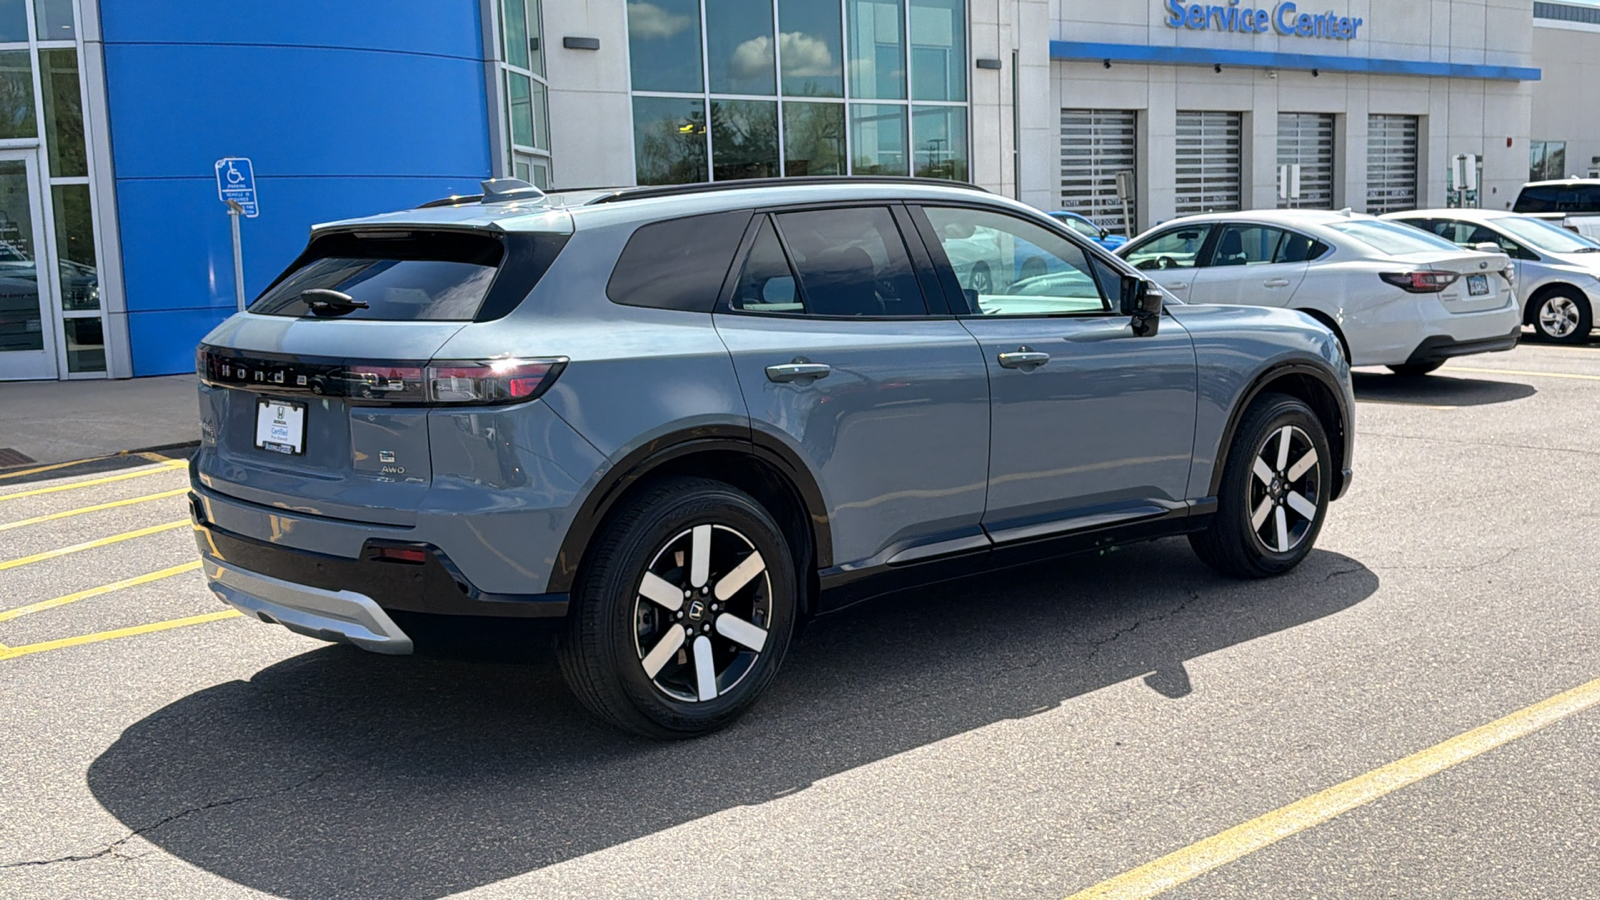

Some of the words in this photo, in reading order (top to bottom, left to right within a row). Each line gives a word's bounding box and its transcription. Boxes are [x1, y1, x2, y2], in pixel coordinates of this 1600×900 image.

[1167, 0, 1269, 33] Service
[1275, 1, 1363, 39] Center
[221, 364, 308, 386] Honda
